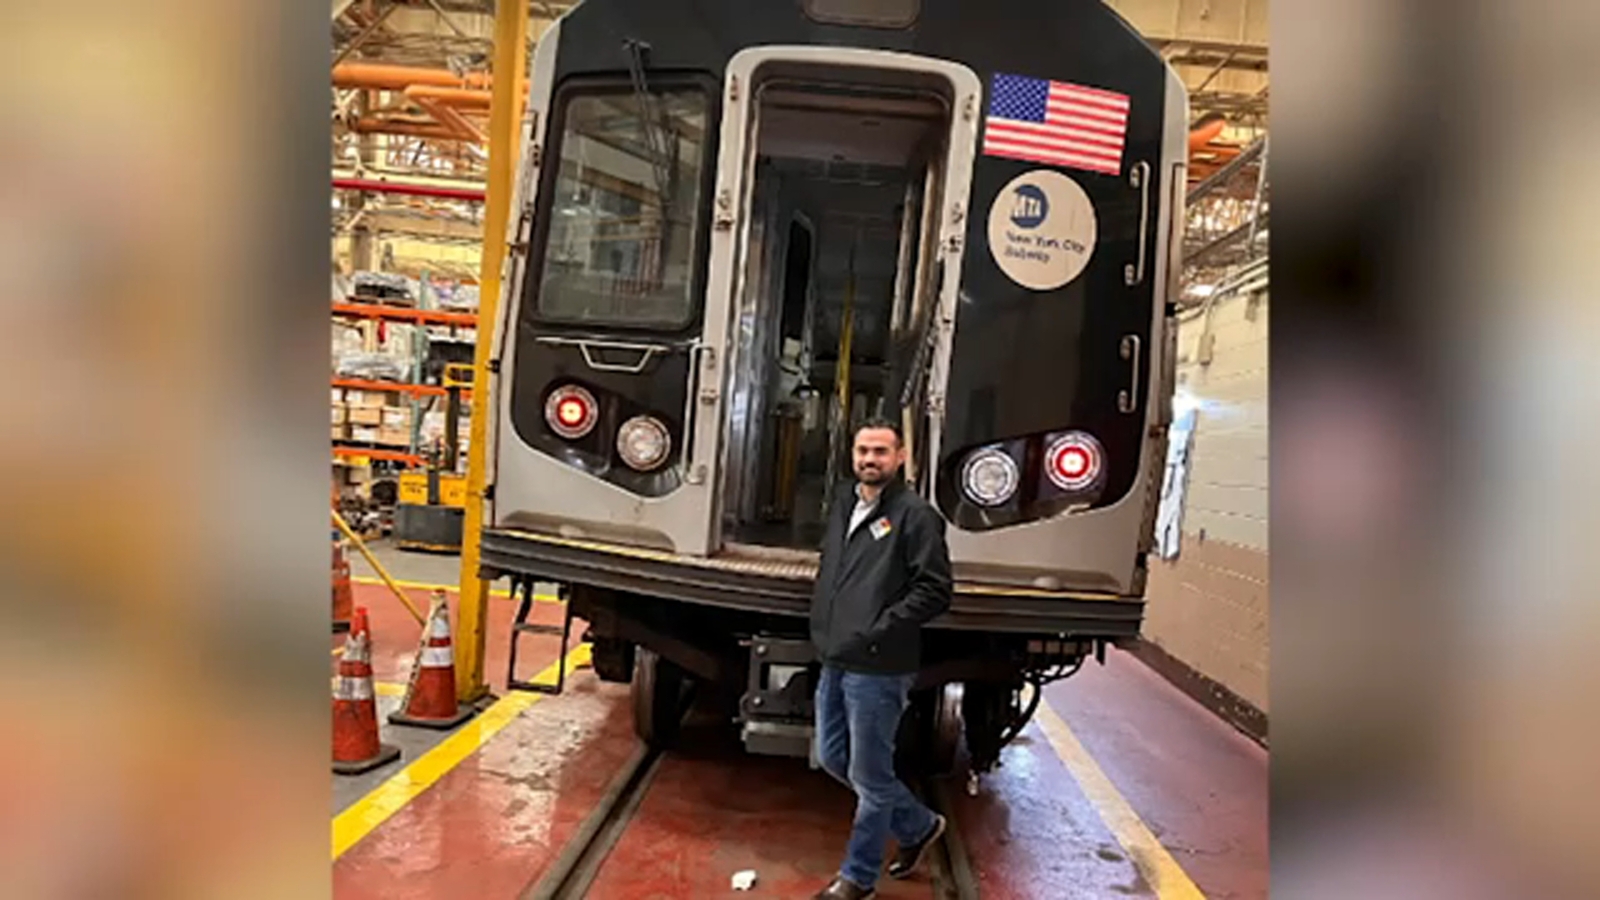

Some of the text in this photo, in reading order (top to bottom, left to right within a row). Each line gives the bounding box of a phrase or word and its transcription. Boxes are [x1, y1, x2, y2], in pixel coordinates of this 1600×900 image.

[1010, 192, 1042, 218] MTA
[1006, 231, 1085, 255] New York City
